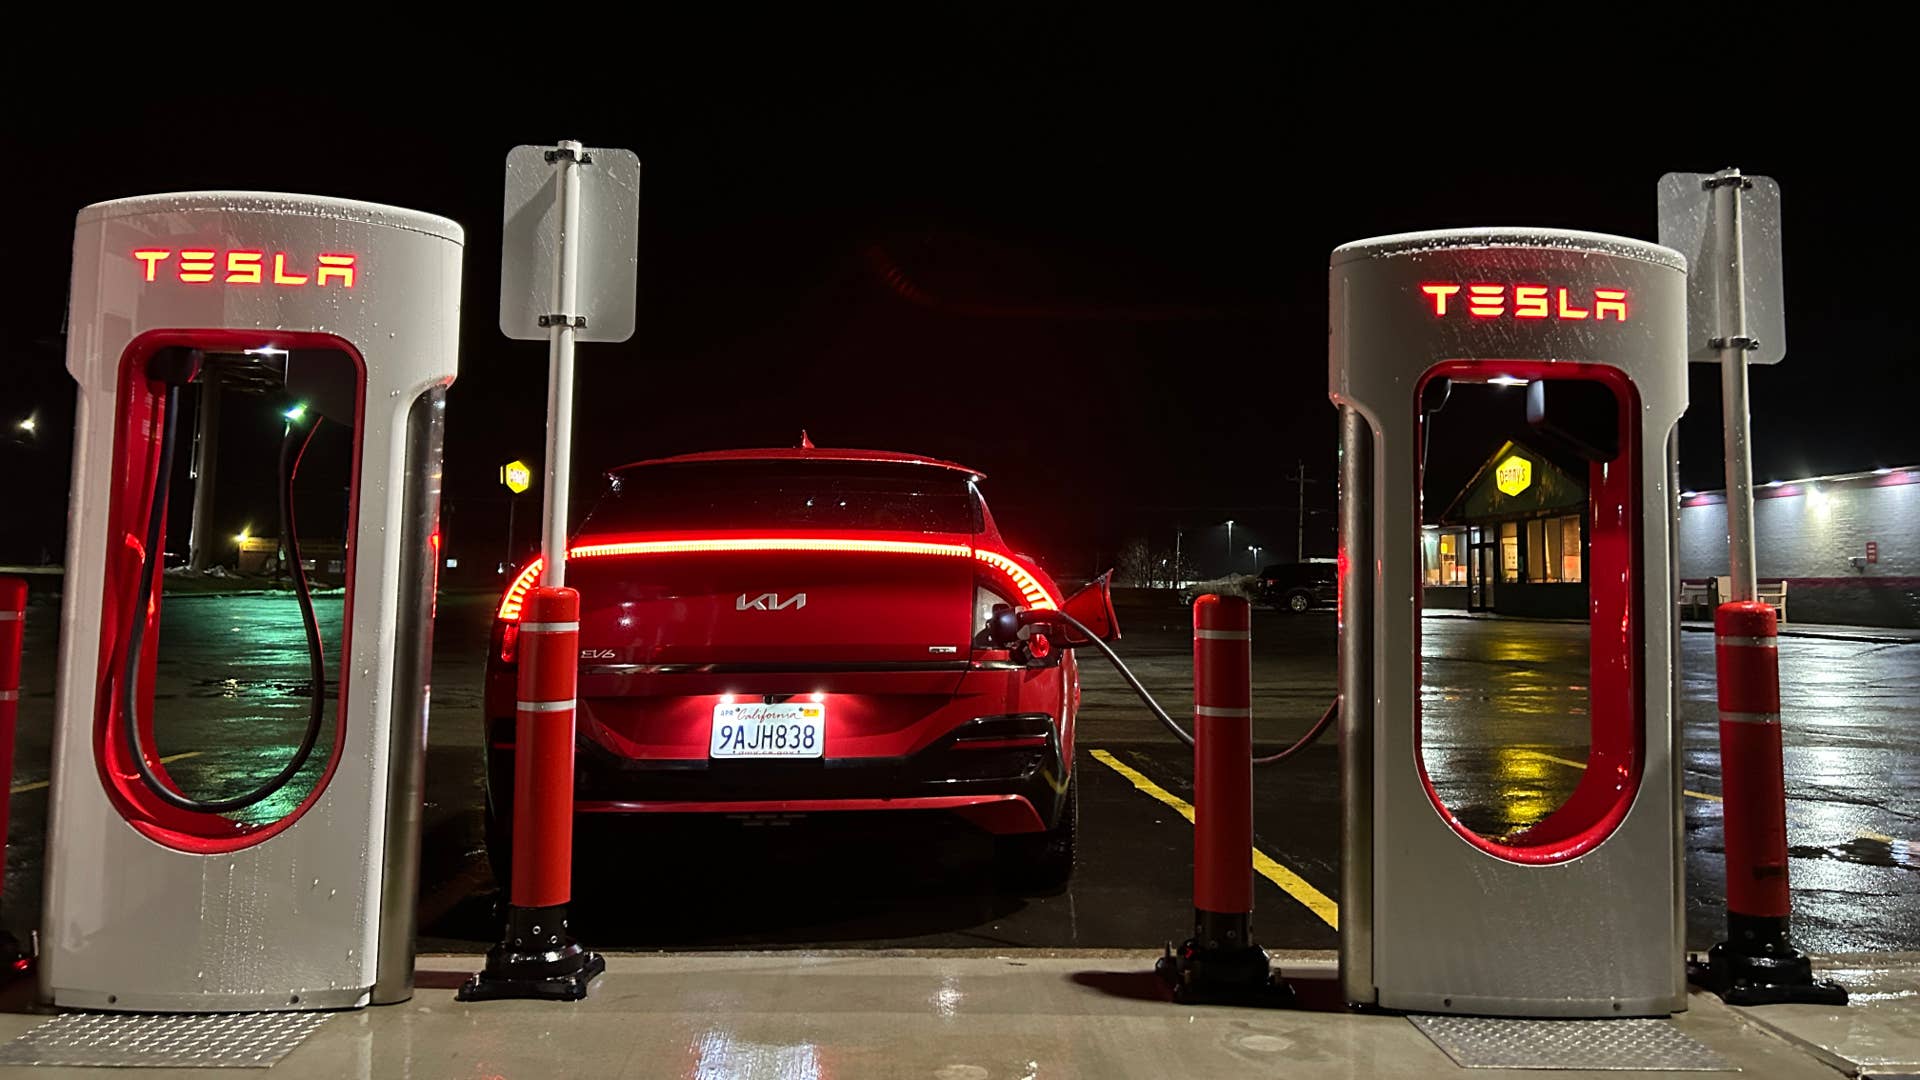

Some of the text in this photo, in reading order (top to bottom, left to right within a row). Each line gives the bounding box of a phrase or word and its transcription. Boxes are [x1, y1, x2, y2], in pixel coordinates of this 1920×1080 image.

[134, 250, 355, 288] TESLA
[1422, 285, 1627, 321] TESLA
[736, 593, 806, 610] KIA
[581, 649, 616, 659] EV6
[737, 707, 801, 723] California
[719, 724, 815, 749] 9AJH838
